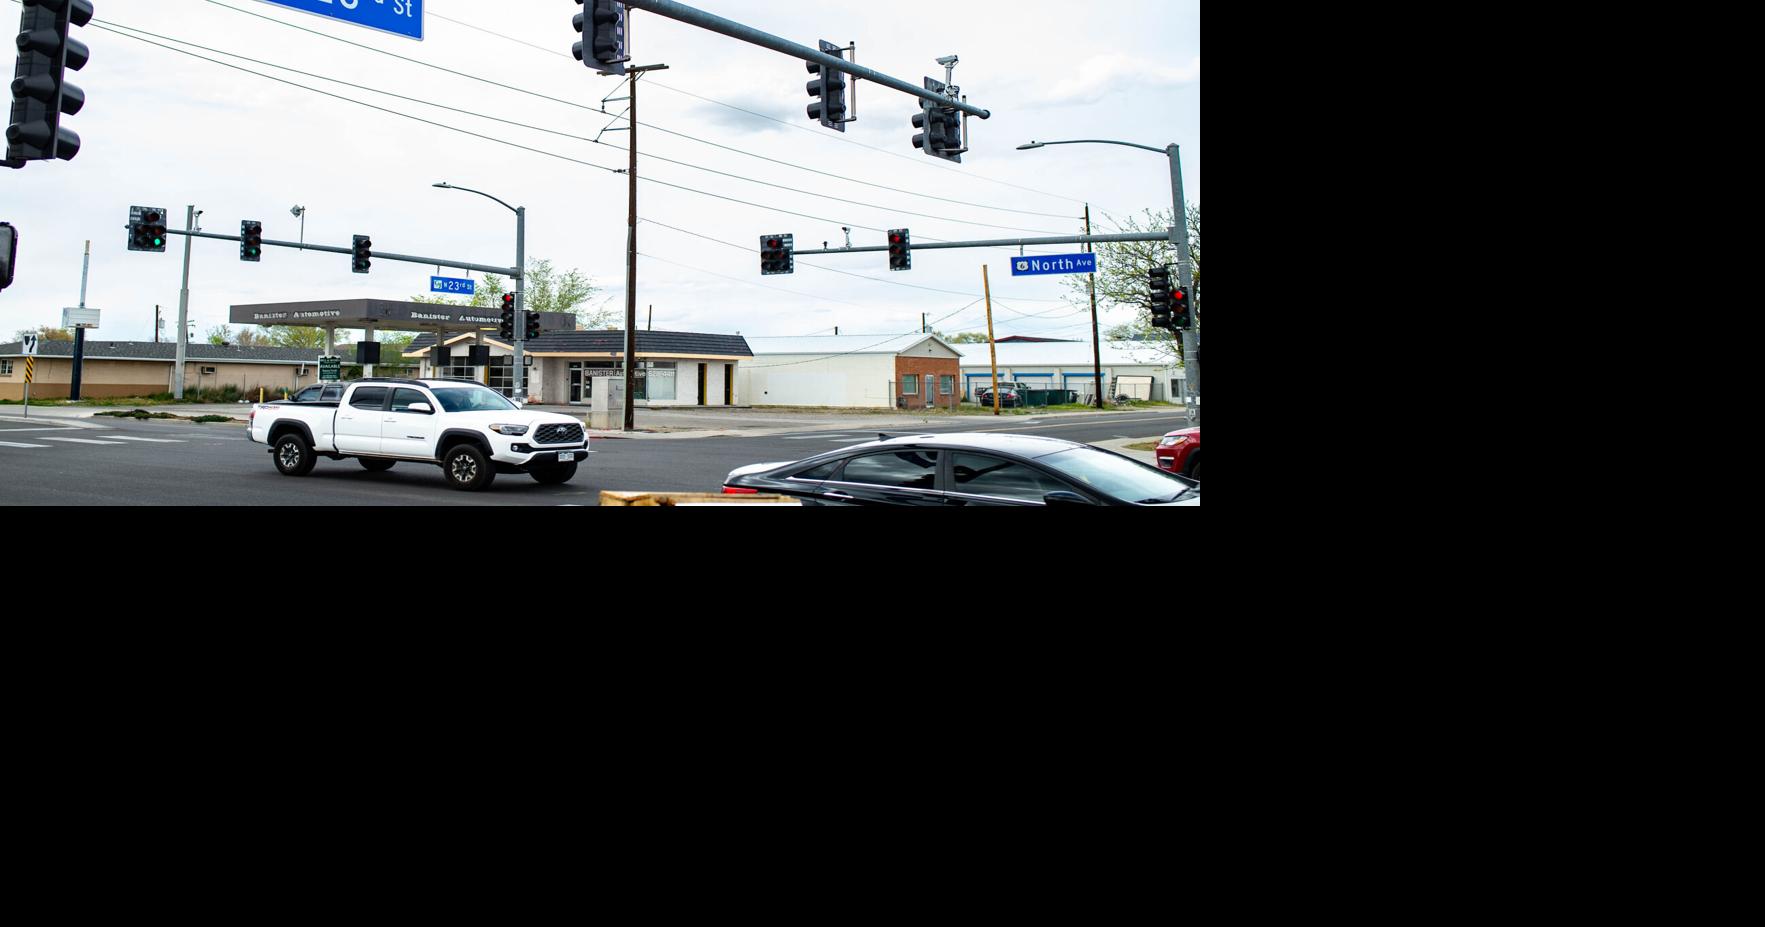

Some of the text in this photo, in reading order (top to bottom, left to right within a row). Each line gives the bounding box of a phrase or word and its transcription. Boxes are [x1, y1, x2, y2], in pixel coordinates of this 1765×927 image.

[1031, 259, 1074, 271] North
[448, 281, 466, 290] 23rd
[293, 310, 340, 318] Automotive
[410, 311, 450, 320] Banister
[584, 369, 614, 377] BANISTER
